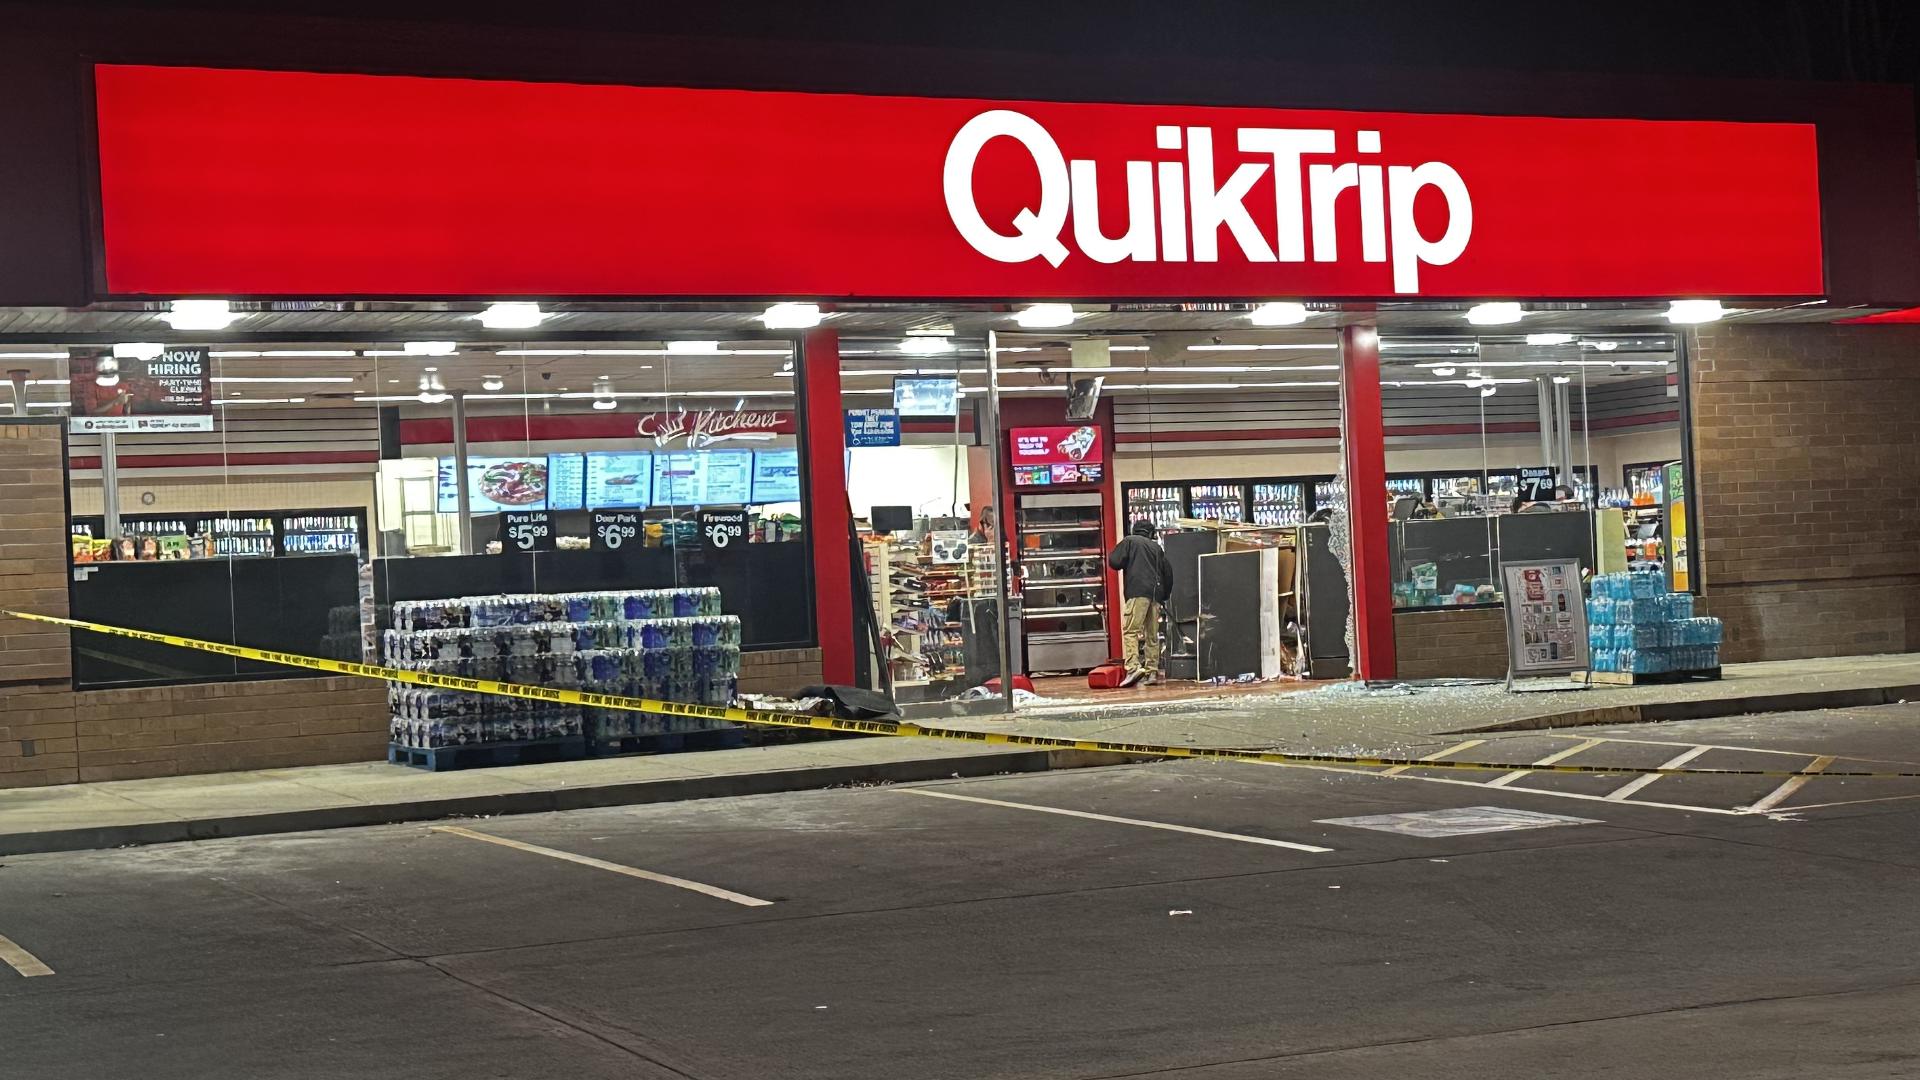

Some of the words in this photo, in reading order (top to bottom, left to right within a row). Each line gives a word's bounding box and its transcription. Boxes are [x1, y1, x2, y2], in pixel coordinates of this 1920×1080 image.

[943, 109, 1473, 293] QuikTrip
[163, 351, 200, 362] NOW
[148, 364, 202, 375] HIRING
[507, 514, 529, 523] Pure
